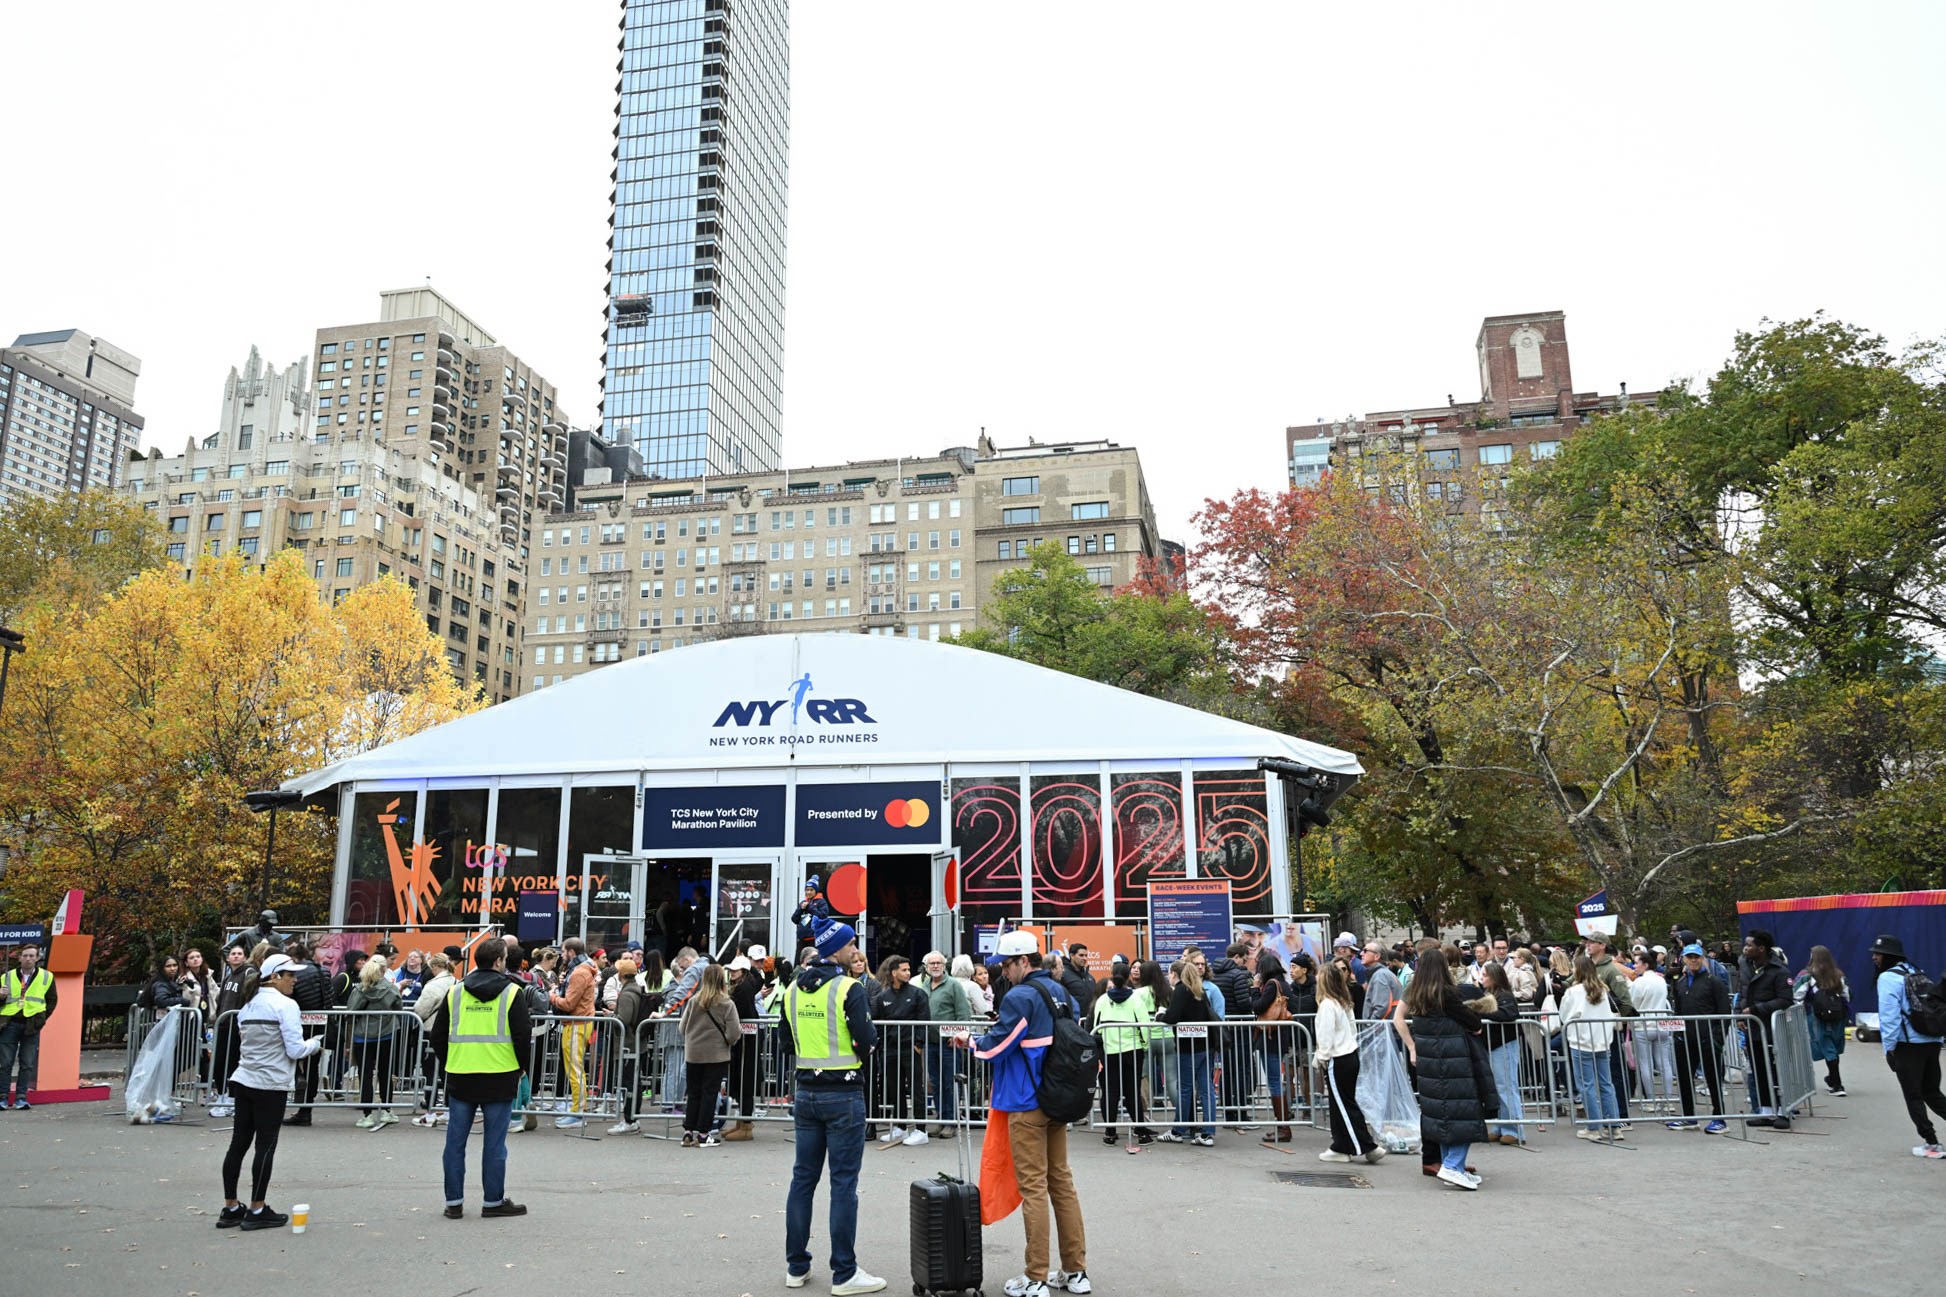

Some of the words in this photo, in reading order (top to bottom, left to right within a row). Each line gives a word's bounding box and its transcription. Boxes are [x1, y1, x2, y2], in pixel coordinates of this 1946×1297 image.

[709, 737, 738, 746] NEW
[742, 736, 775, 745] YORK
[780, 735, 814, 745] ROAD
[819, 733, 878, 743] RUNNERS
[671, 809, 690, 818] TCS
[692, 809, 714, 818] New
[716, 808, 737, 817] York
[739, 807, 759, 818] City
[807, 808, 861, 819] Presented
[864, 808, 878, 819] by
[671, 820, 717, 829] Marathon
[719, 819, 757, 828] Pavilion
[951, 779, 1272, 905] 2025
[465, 839, 508, 868] tcs
[462, 876, 507, 893] NEW
[511, 875, 561, 892] YORK
[565, 874, 608, 891] CITY
[461, 897, 568, 913] MARAN
[1581, 903, 1605, 913] 2025
